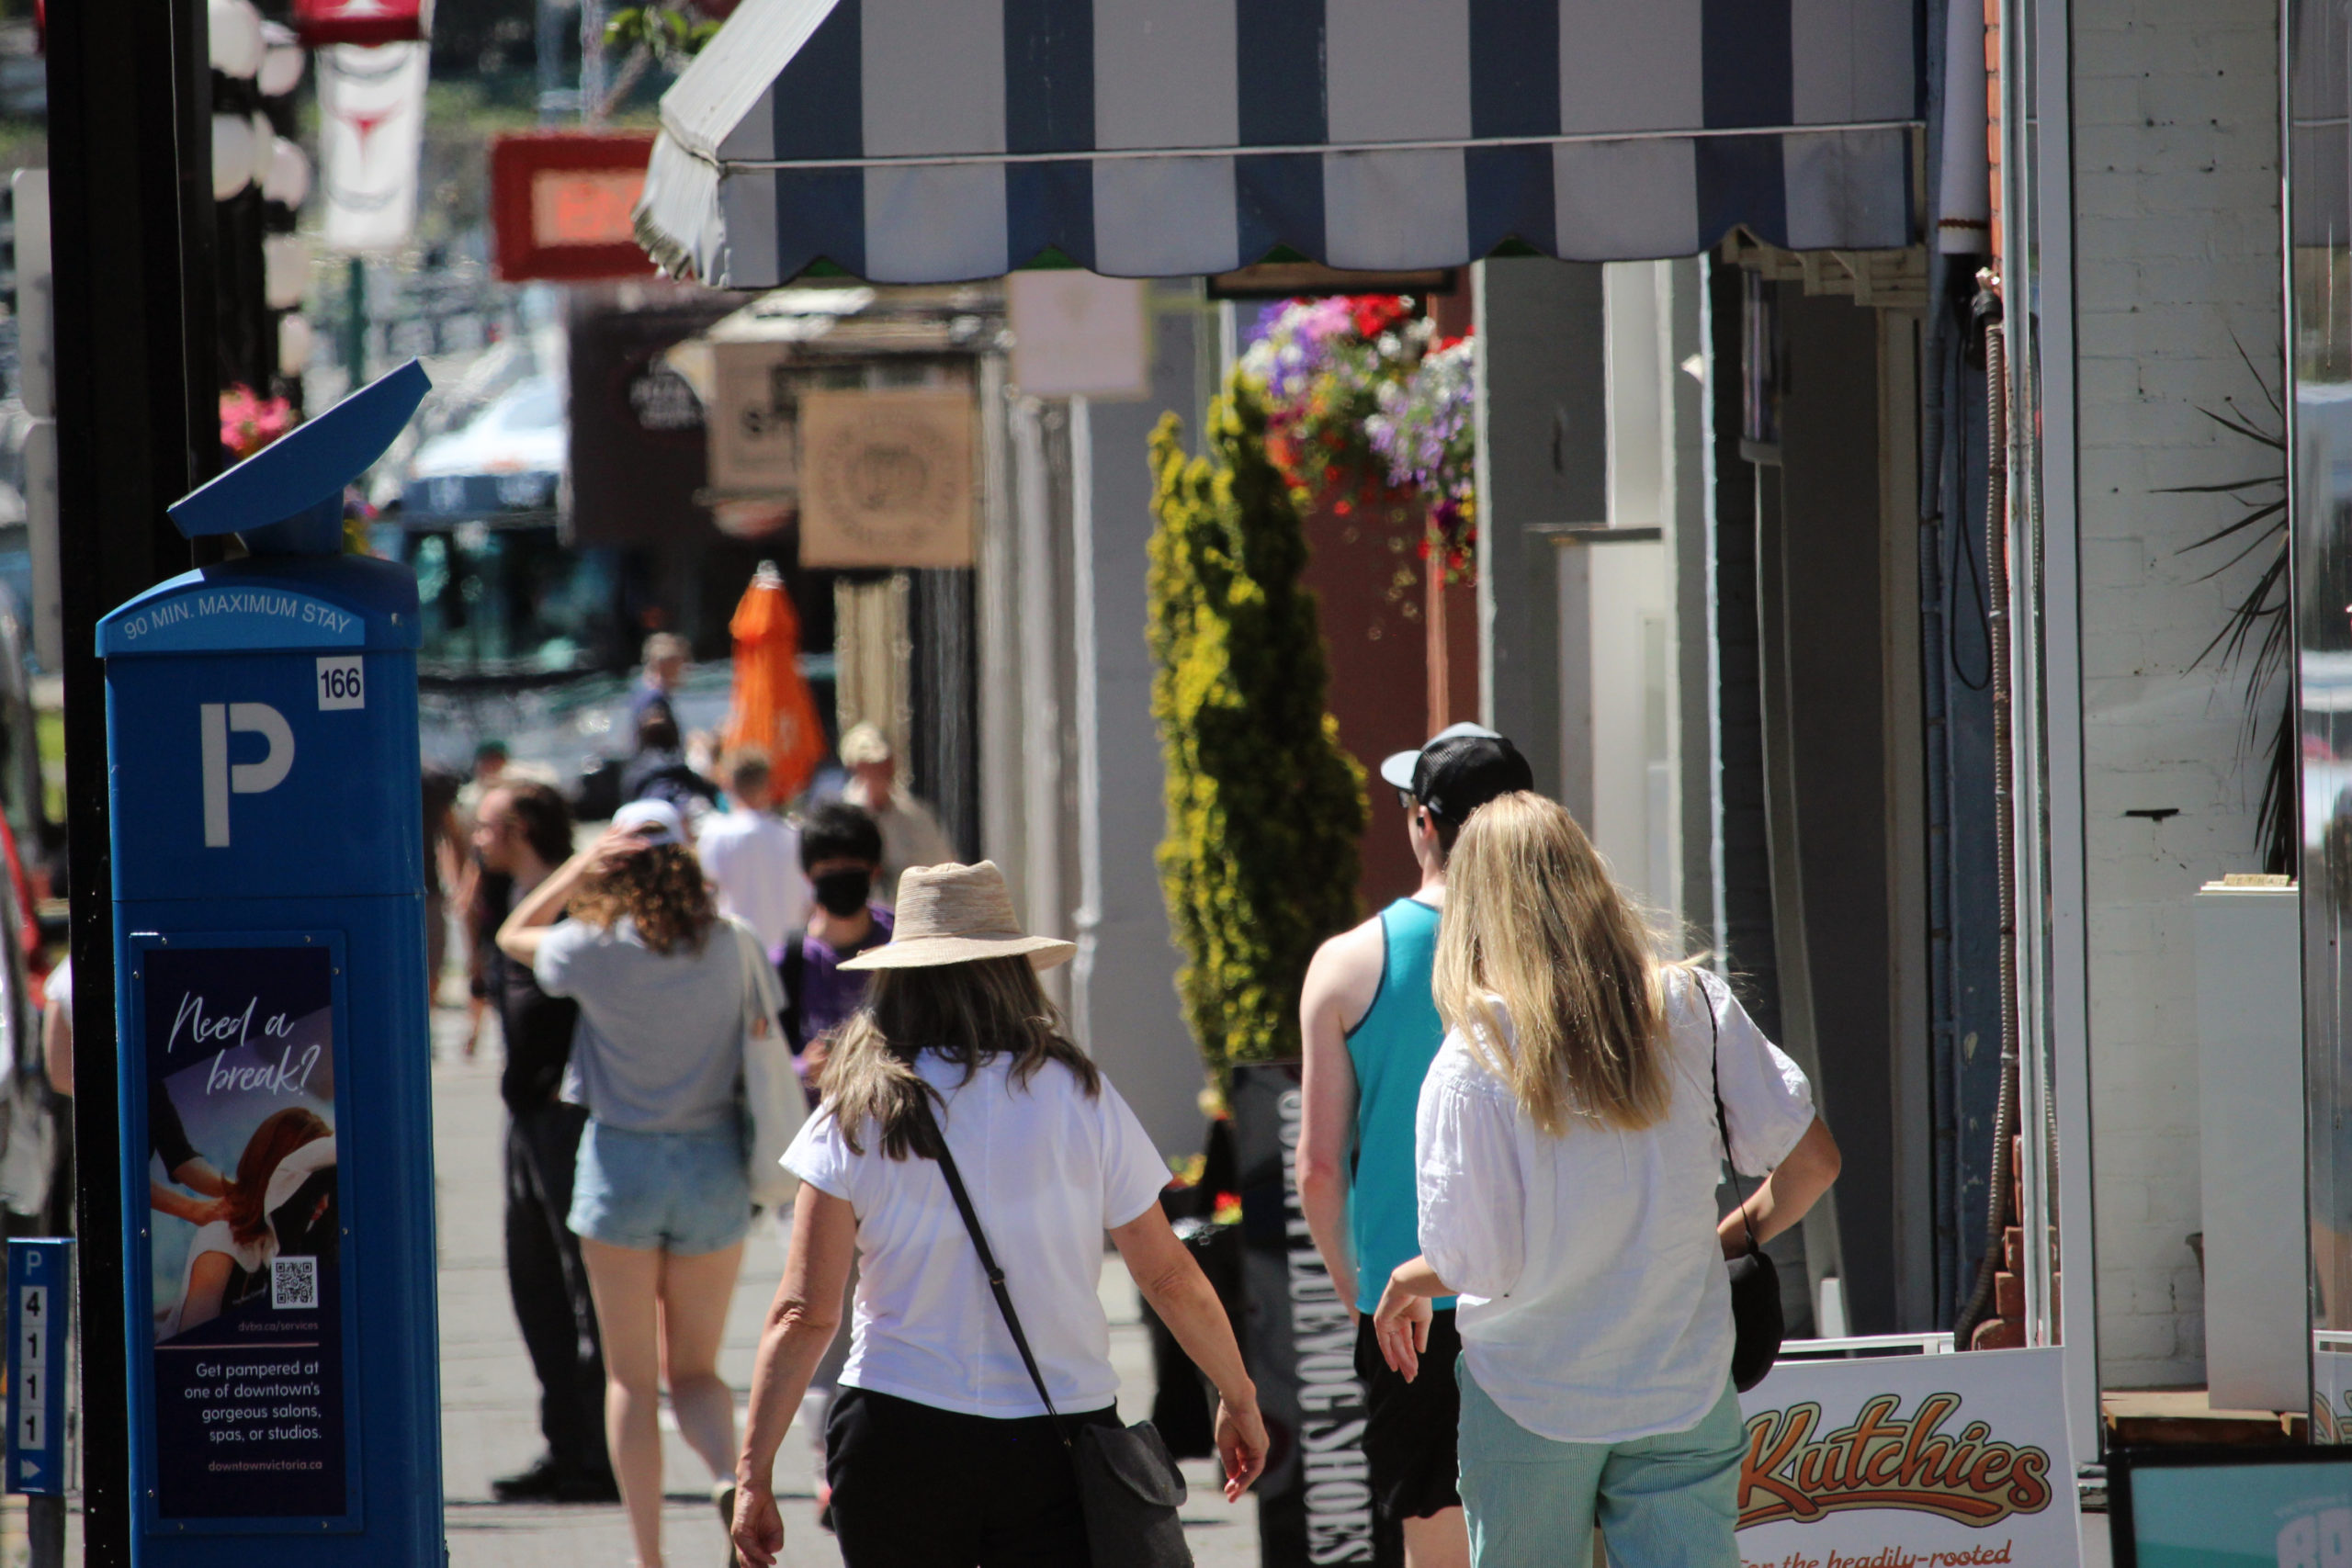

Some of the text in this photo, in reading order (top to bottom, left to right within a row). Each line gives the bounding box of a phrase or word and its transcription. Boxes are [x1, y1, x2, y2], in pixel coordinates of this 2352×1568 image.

[124, 593, 351, 640] 90 MIN. MAXIMUM STAY
[320, 667, 361, 698] 166
[200, 702, 295, 848] P
[168, 991, 294, 1053] Need a
[206, 1044, 321, 1096] break?
[25, 1249, 43, 1277] P
[196, 1360, 319, 1379] Get pampered at
[184, 1382, 320, 1399] one of downtown's
[201, 1404, 322, 1423] gorgeous salons,
[209, 1424, 322, 1444] spas, or studios.
[208, 1459, 322, 1472] downtownvictoria.ca
[1736, 1393, 2052, 1522] Kutchies
[1300, 1418, 1374, 1564] SHOES
